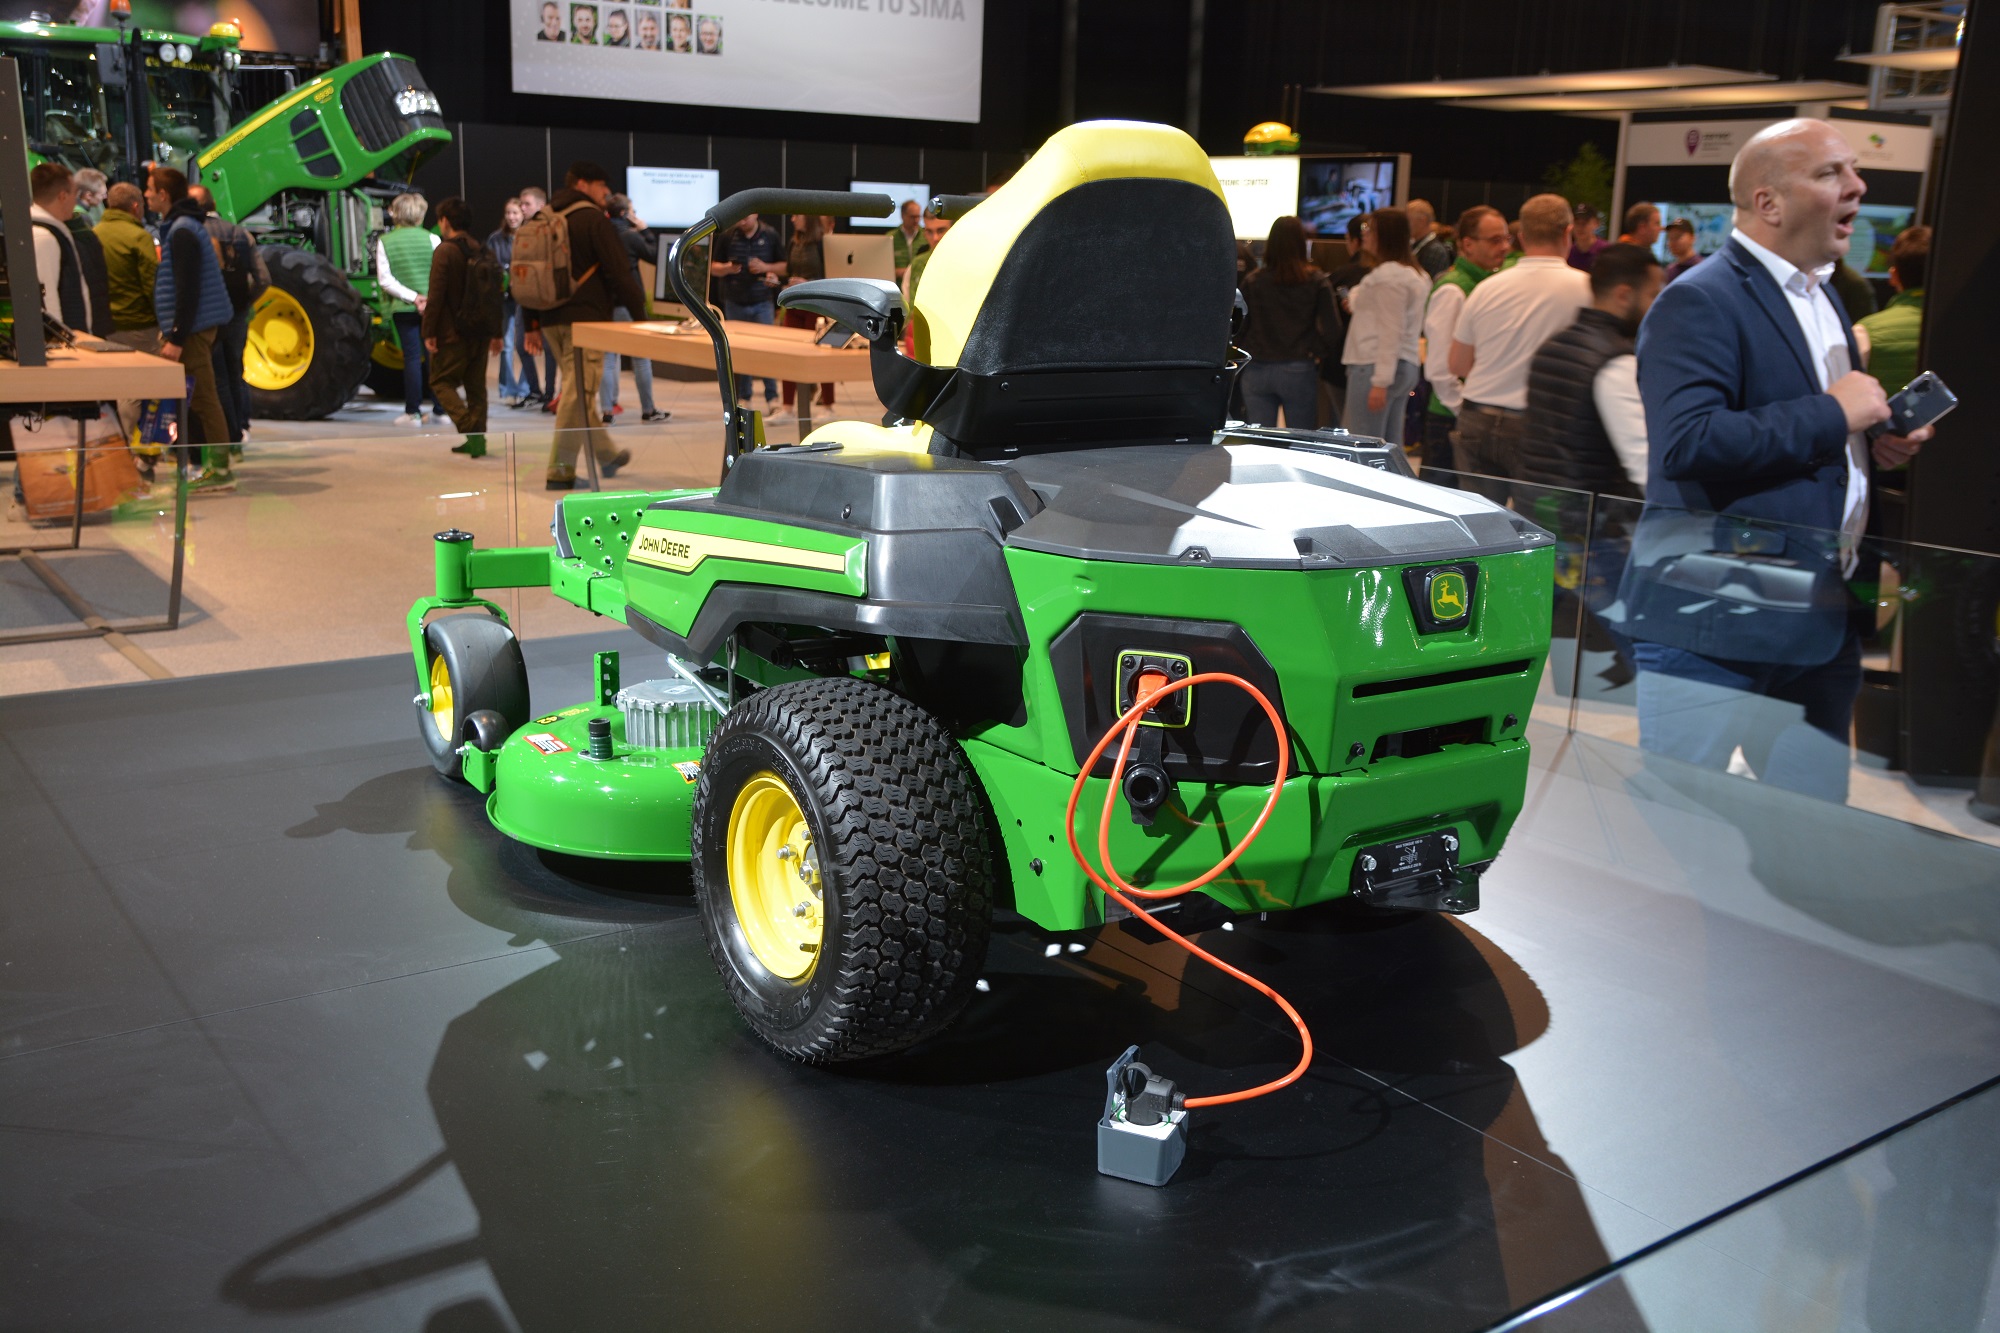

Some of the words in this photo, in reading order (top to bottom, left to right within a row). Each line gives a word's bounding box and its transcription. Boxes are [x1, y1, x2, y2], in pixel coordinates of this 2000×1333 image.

[909, 0, 966, 21] SIMA
[639, 534, 659, 552] JOHN
[661, 538, 690, 558] DEERE
